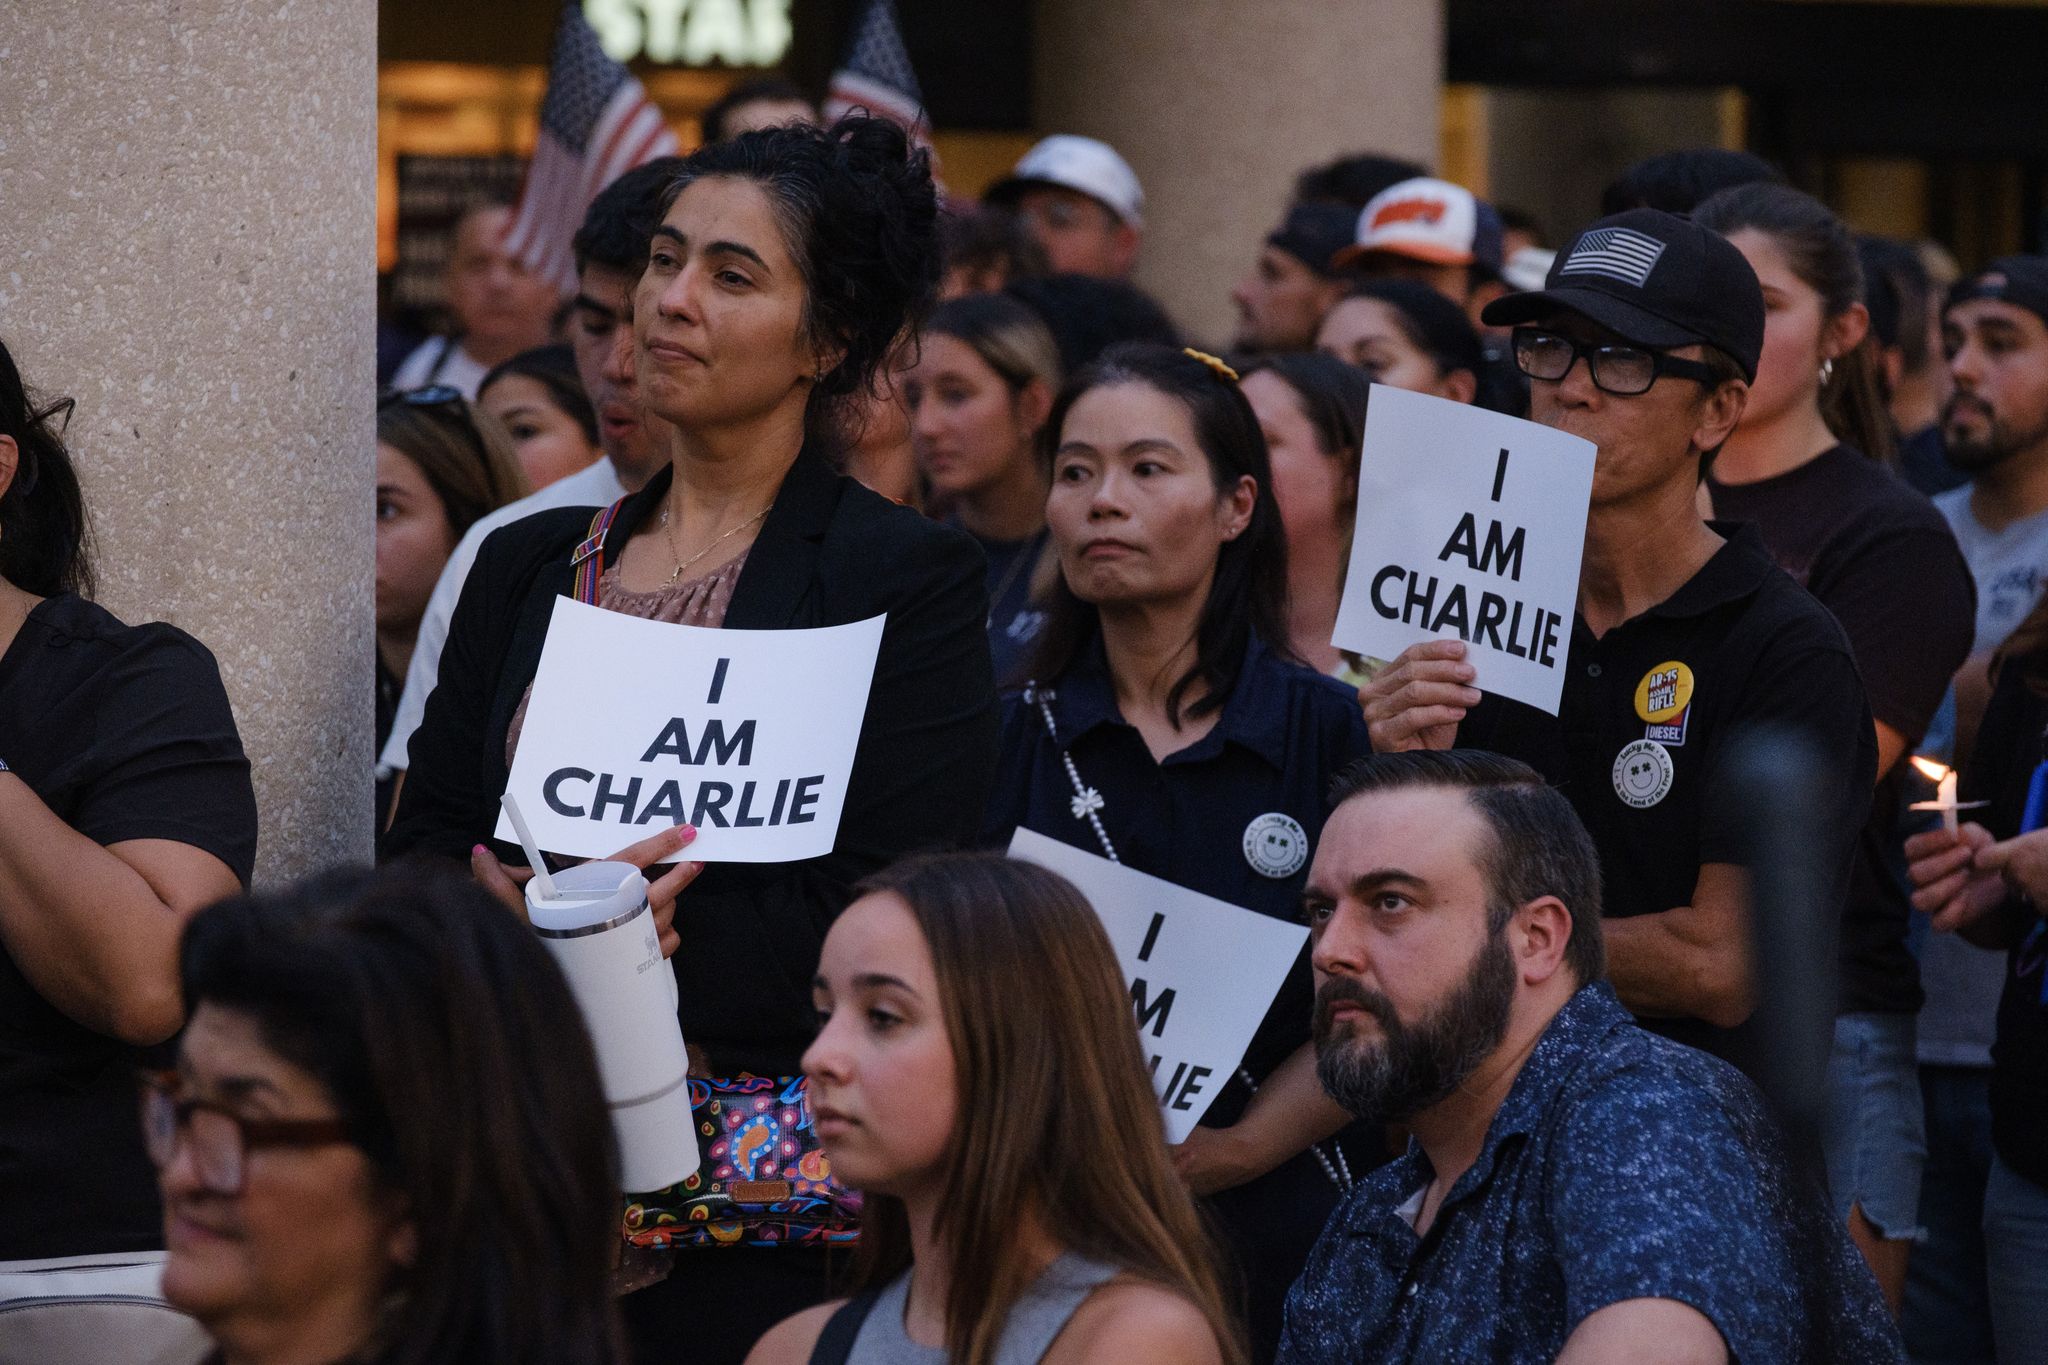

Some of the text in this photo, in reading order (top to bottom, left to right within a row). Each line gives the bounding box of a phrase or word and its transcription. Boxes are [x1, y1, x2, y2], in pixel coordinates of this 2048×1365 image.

[1491, 448, 1510, 502] I
[1437, 512, 1526, 582] AM
[1370, 564, 1562, 668] CHARLIE
[706, 658, 730, 704] I
[1648, 693, 1676, 713] RIFLE
[639, 717, 757, 766] AM
[1649, 725, 1681, 740] DIESEL
[542, 767, 825, 828] CHARLIE
[1137, 912, 1166, 962] I
[1129, 977, 1177, 1038] M
